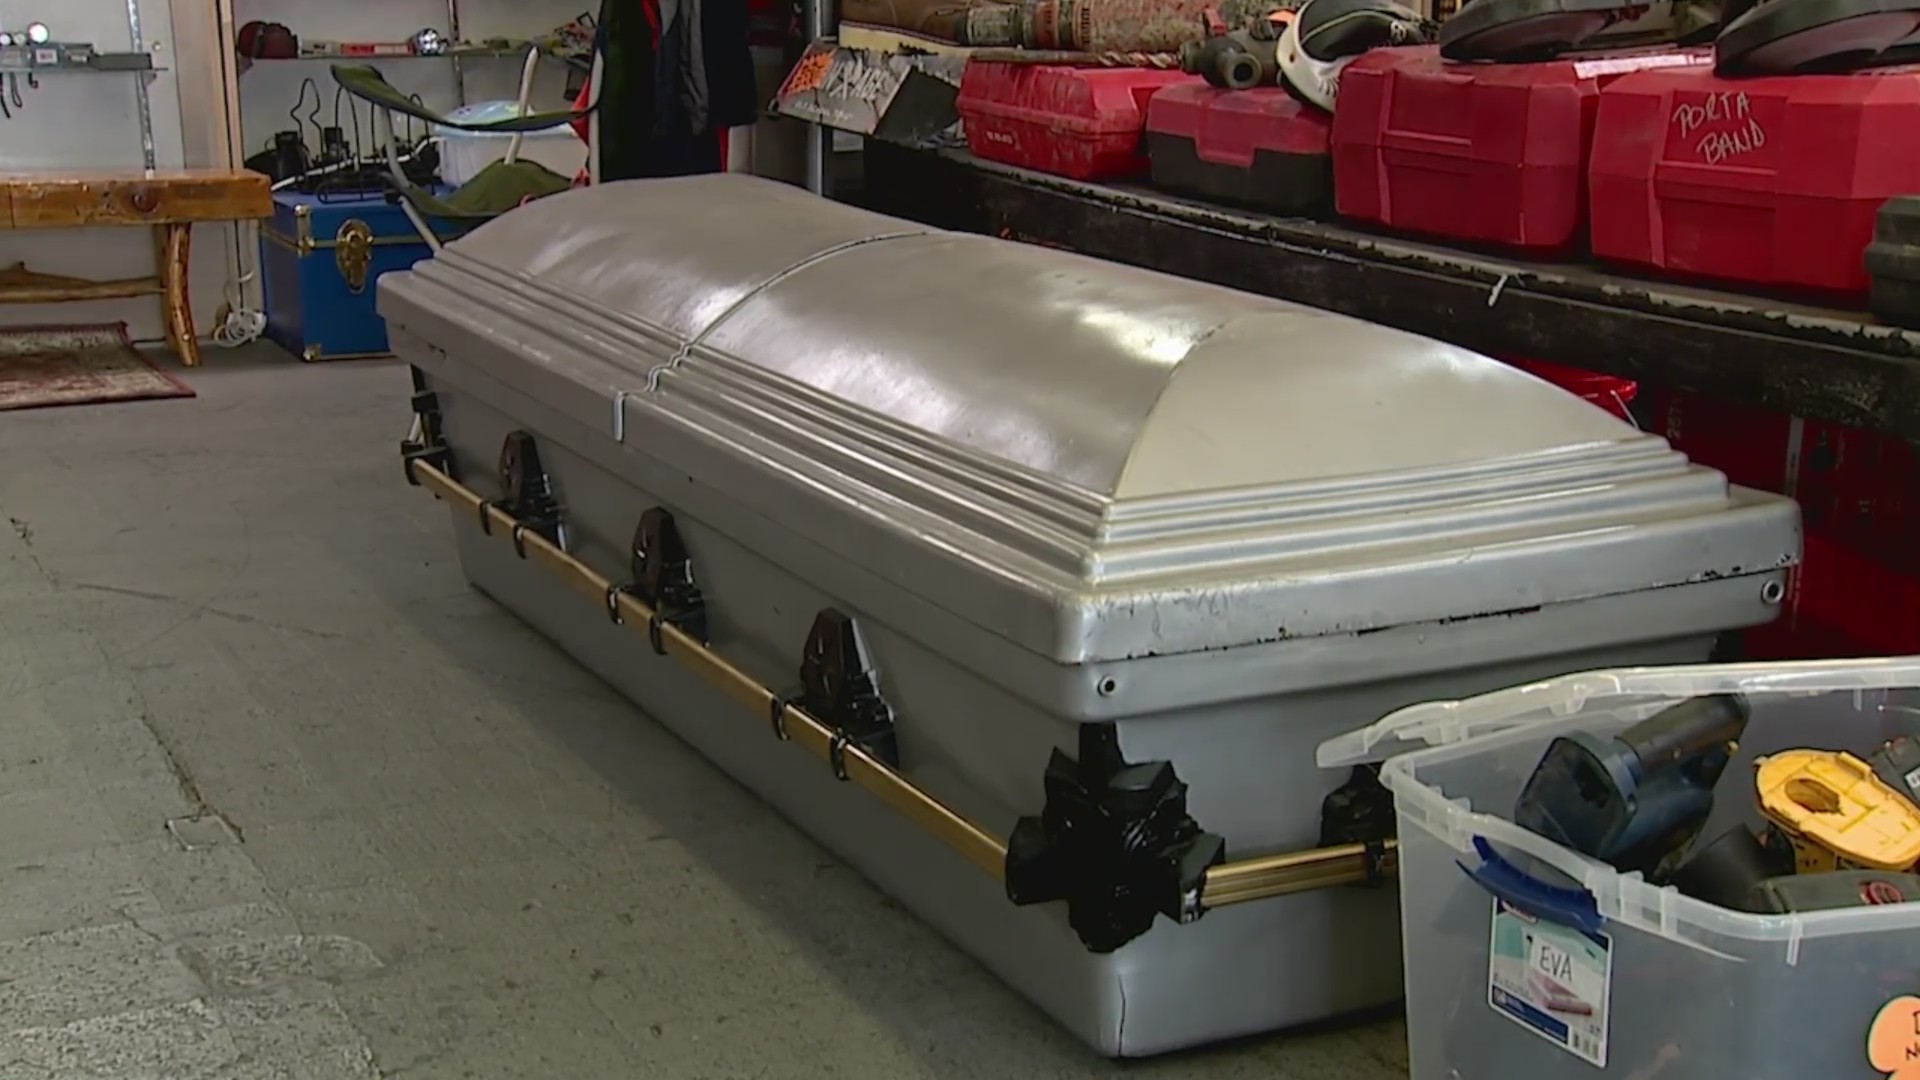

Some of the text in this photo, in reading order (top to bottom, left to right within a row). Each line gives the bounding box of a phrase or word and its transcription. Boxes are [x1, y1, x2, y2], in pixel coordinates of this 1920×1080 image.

[1672, 91, 1750, 139] PORTA
[1696, 118, 1765, 165] BAND
[1539, 945, 1573, 982] EVA
